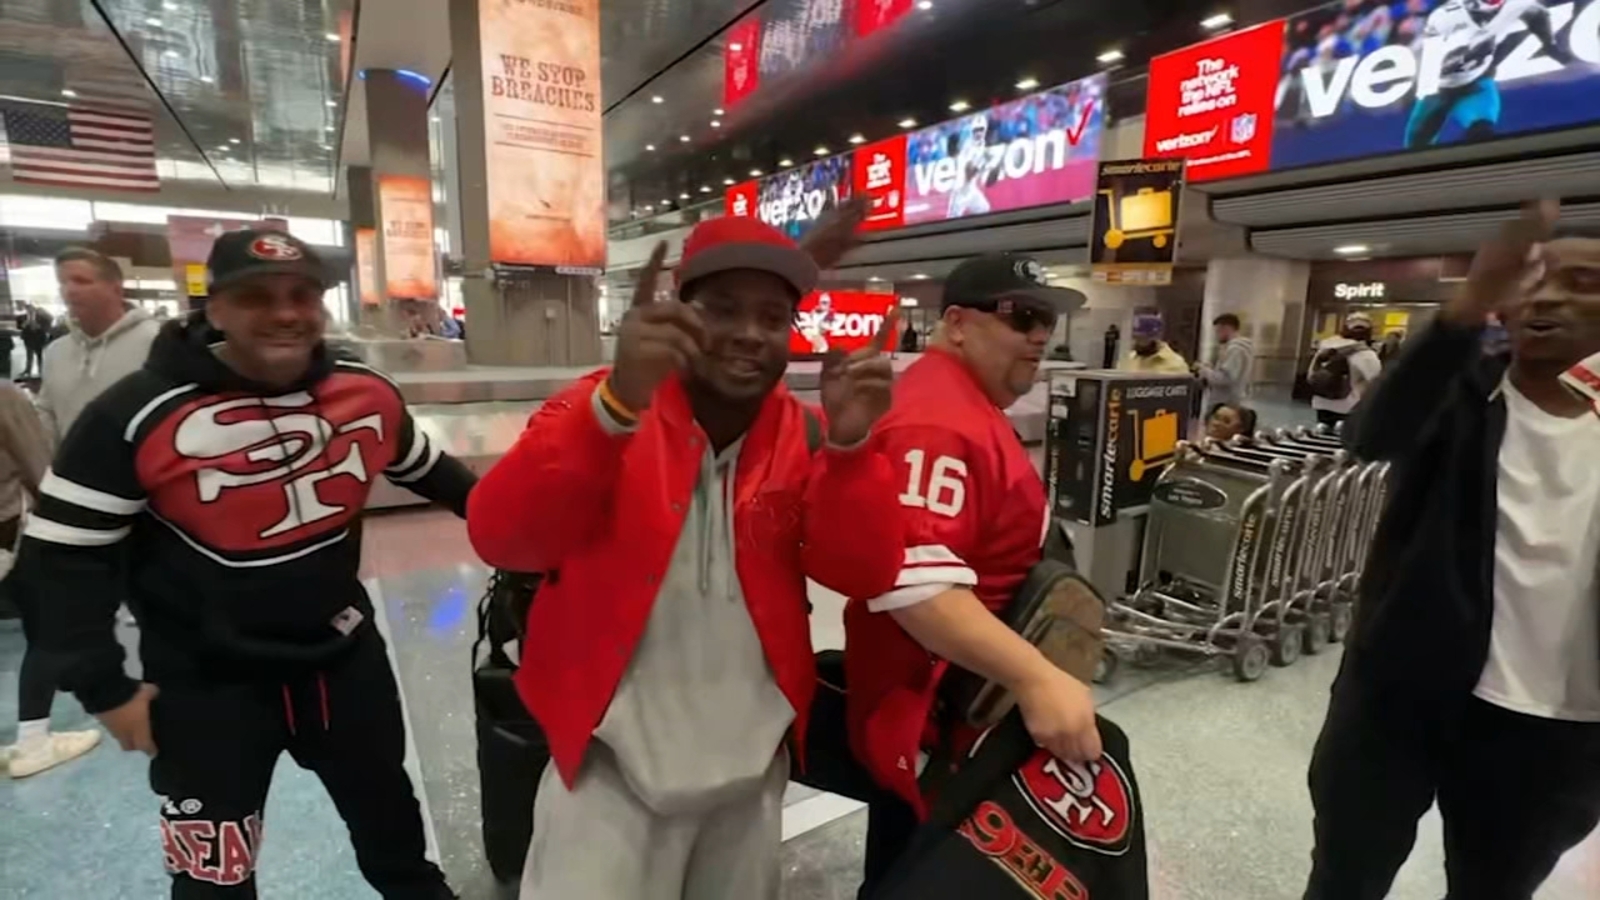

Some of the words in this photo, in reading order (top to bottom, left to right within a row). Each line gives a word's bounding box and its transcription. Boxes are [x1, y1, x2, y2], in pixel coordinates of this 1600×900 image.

[500, 54, 532, 80] WE
[537, 61, 586, 88] STOP
[1196, 58, 1225, 76] The
[491, 75, 595, 112] BREACHES
[915, 128, 1065, 195] verzon
[1334, 282, 1385, 300] Spirit
[1126, 385, 1165, 399] LUGGAGE
[898, 448, 968, 518] 16
